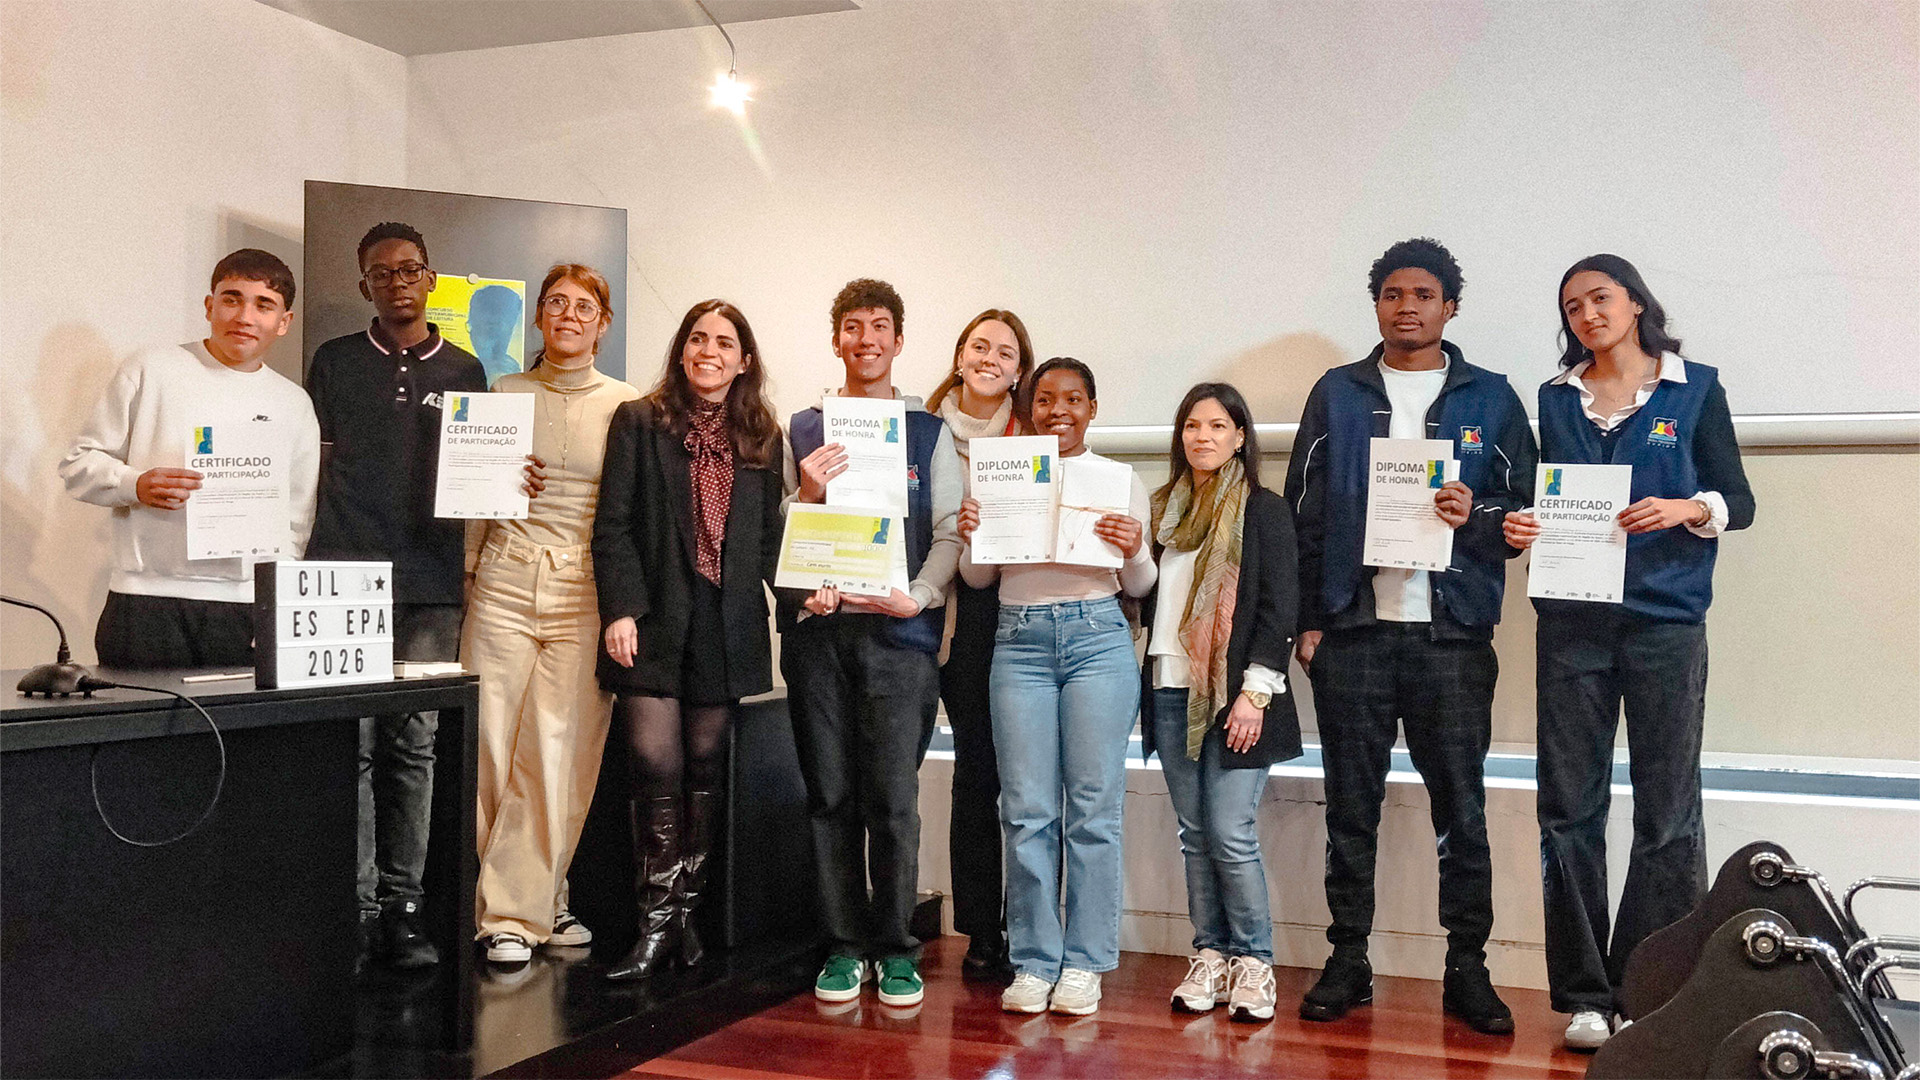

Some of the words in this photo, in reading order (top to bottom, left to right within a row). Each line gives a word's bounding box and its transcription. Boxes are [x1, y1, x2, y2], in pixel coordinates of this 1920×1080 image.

[831, 417, 881, 429] DIPLOMA
[446, 424, 518, 435] CERTIFICADO
[845, 430, 876, 439] HONRA
[447, 437, 458, 445] DE
[460, 437, 516, 447] PARTICIPAÇÃO
[191, 456, 272, 469] CERTIFICADO
[977, 459, 1030, 471] DIPLOMA
[1376, 461, 1426, 474] DIPLOMA
[206, 469, 271, 480] PARTICIPAÇÃO
[977, 474, 989, 483] DE
[991, 473, 1025, 482] HONRA
[1376, 475, 1387, 484] DE
[1389, 475, 1420, 485] HONRA
[1539, 498, 1613, 511] CERTIFICADO
[1540, 512, 1550, 520] DE
[1552, 512, 1611, 523] PARTICIPAÇÃO
[299, 570, 339, 597] CIL
[293, 610, 318, 638] ES
[346, 608, 386, 636] EPA
[308, 648, 364, 677] 2026
